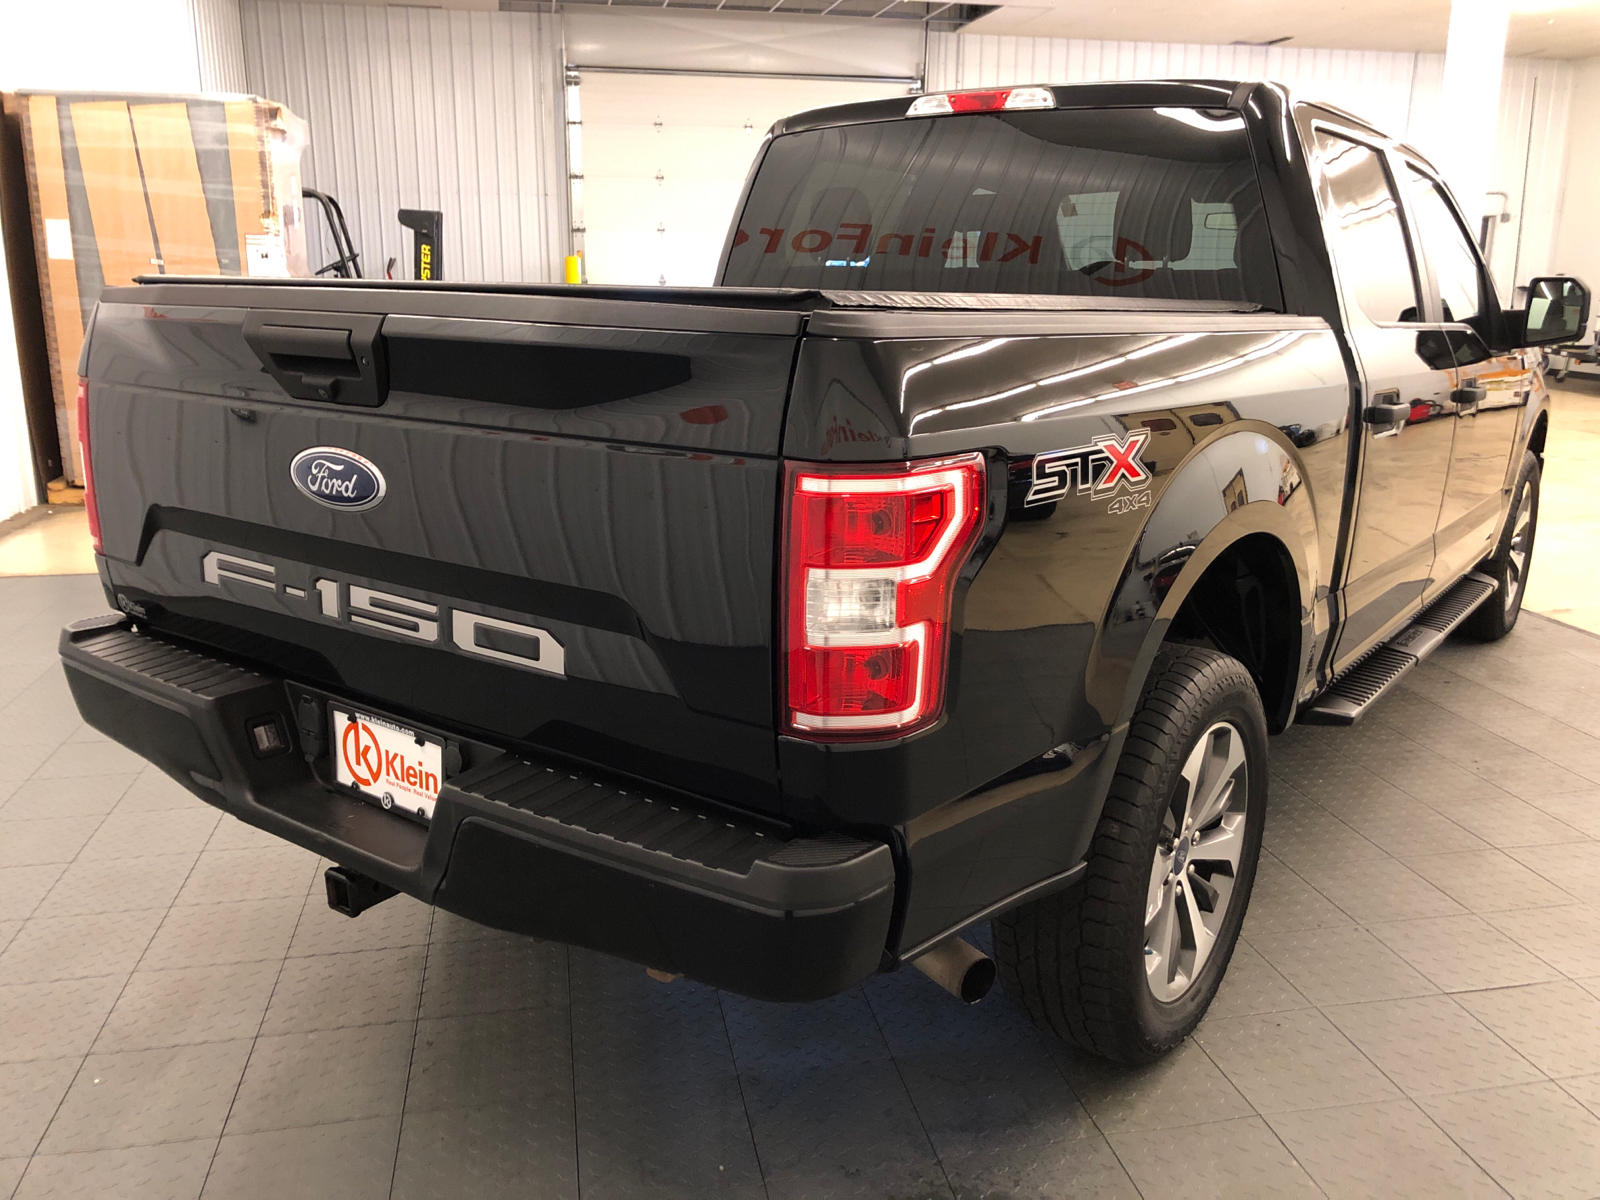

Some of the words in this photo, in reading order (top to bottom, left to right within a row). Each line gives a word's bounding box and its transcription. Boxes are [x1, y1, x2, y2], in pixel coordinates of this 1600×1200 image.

[307, 459, 358, 498] Ford
[1024, 428, 1152, 508] STX
[203, 551, 565, 676] F-150
[385, 749, 438, 795] Klein
